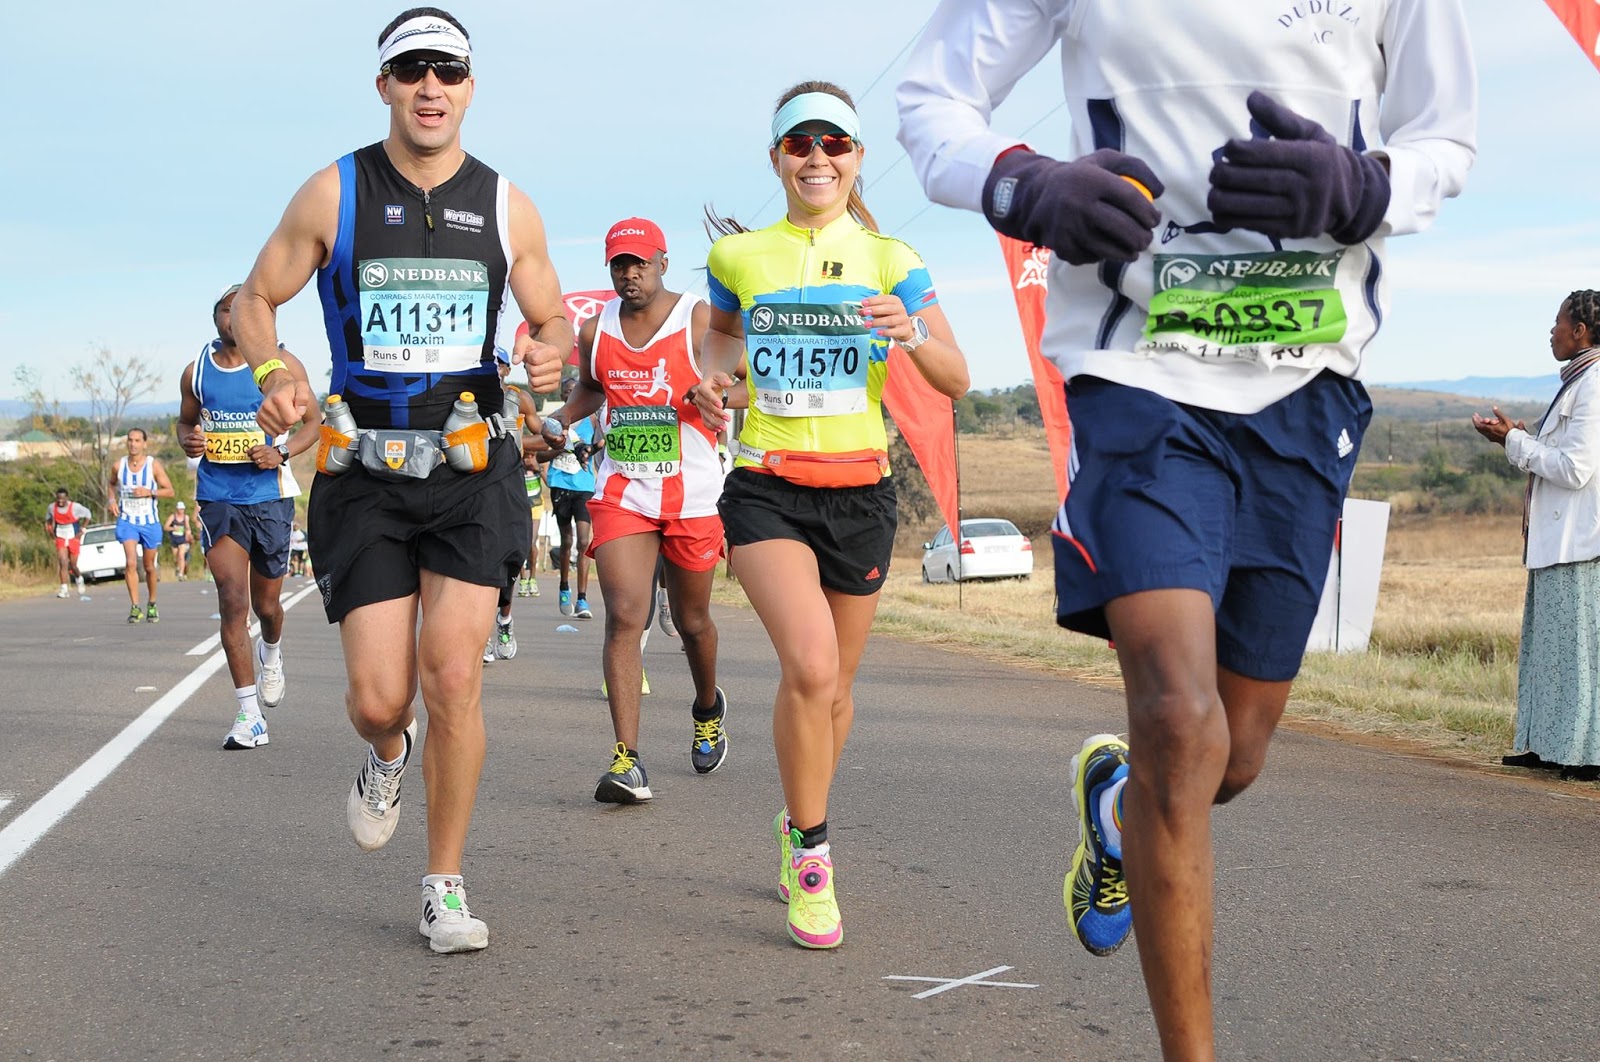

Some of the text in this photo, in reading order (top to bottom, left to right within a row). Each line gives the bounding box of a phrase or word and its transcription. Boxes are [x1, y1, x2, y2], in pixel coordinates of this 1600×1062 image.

[386, 206, 402, 216] NW
[445, 210, 483, 225] World Class
[446, 223, 469, 232] OUTDOOR
[610, 228, 645, 239] RICOH
[1207, 259, 1336, 278] NEDBANK
[393, 268, 485, 282] NEDBANK
[366, 302, 474, 332] A11311
[777, 313, 865, 327] NEDBANK
[400, 333, 445, 345] Maxim
[840, 337, 857, 345] 2014
[373, 348, 411, 361] Runs 0
[753, 346, 859, 378] C11570
[608, 370, 649, 379] RICOH
[788, 378, 822, 390] Yulia
[763, 392, 794, 405] Runs 0
[211, 410, 257, 421] Discove
[619, 412, 676, 421] NEDBANK
[606, 433, 673, 454] B47239
[740, 447, 765, 460] ATHA
[655, 462, 673, 474] 40
